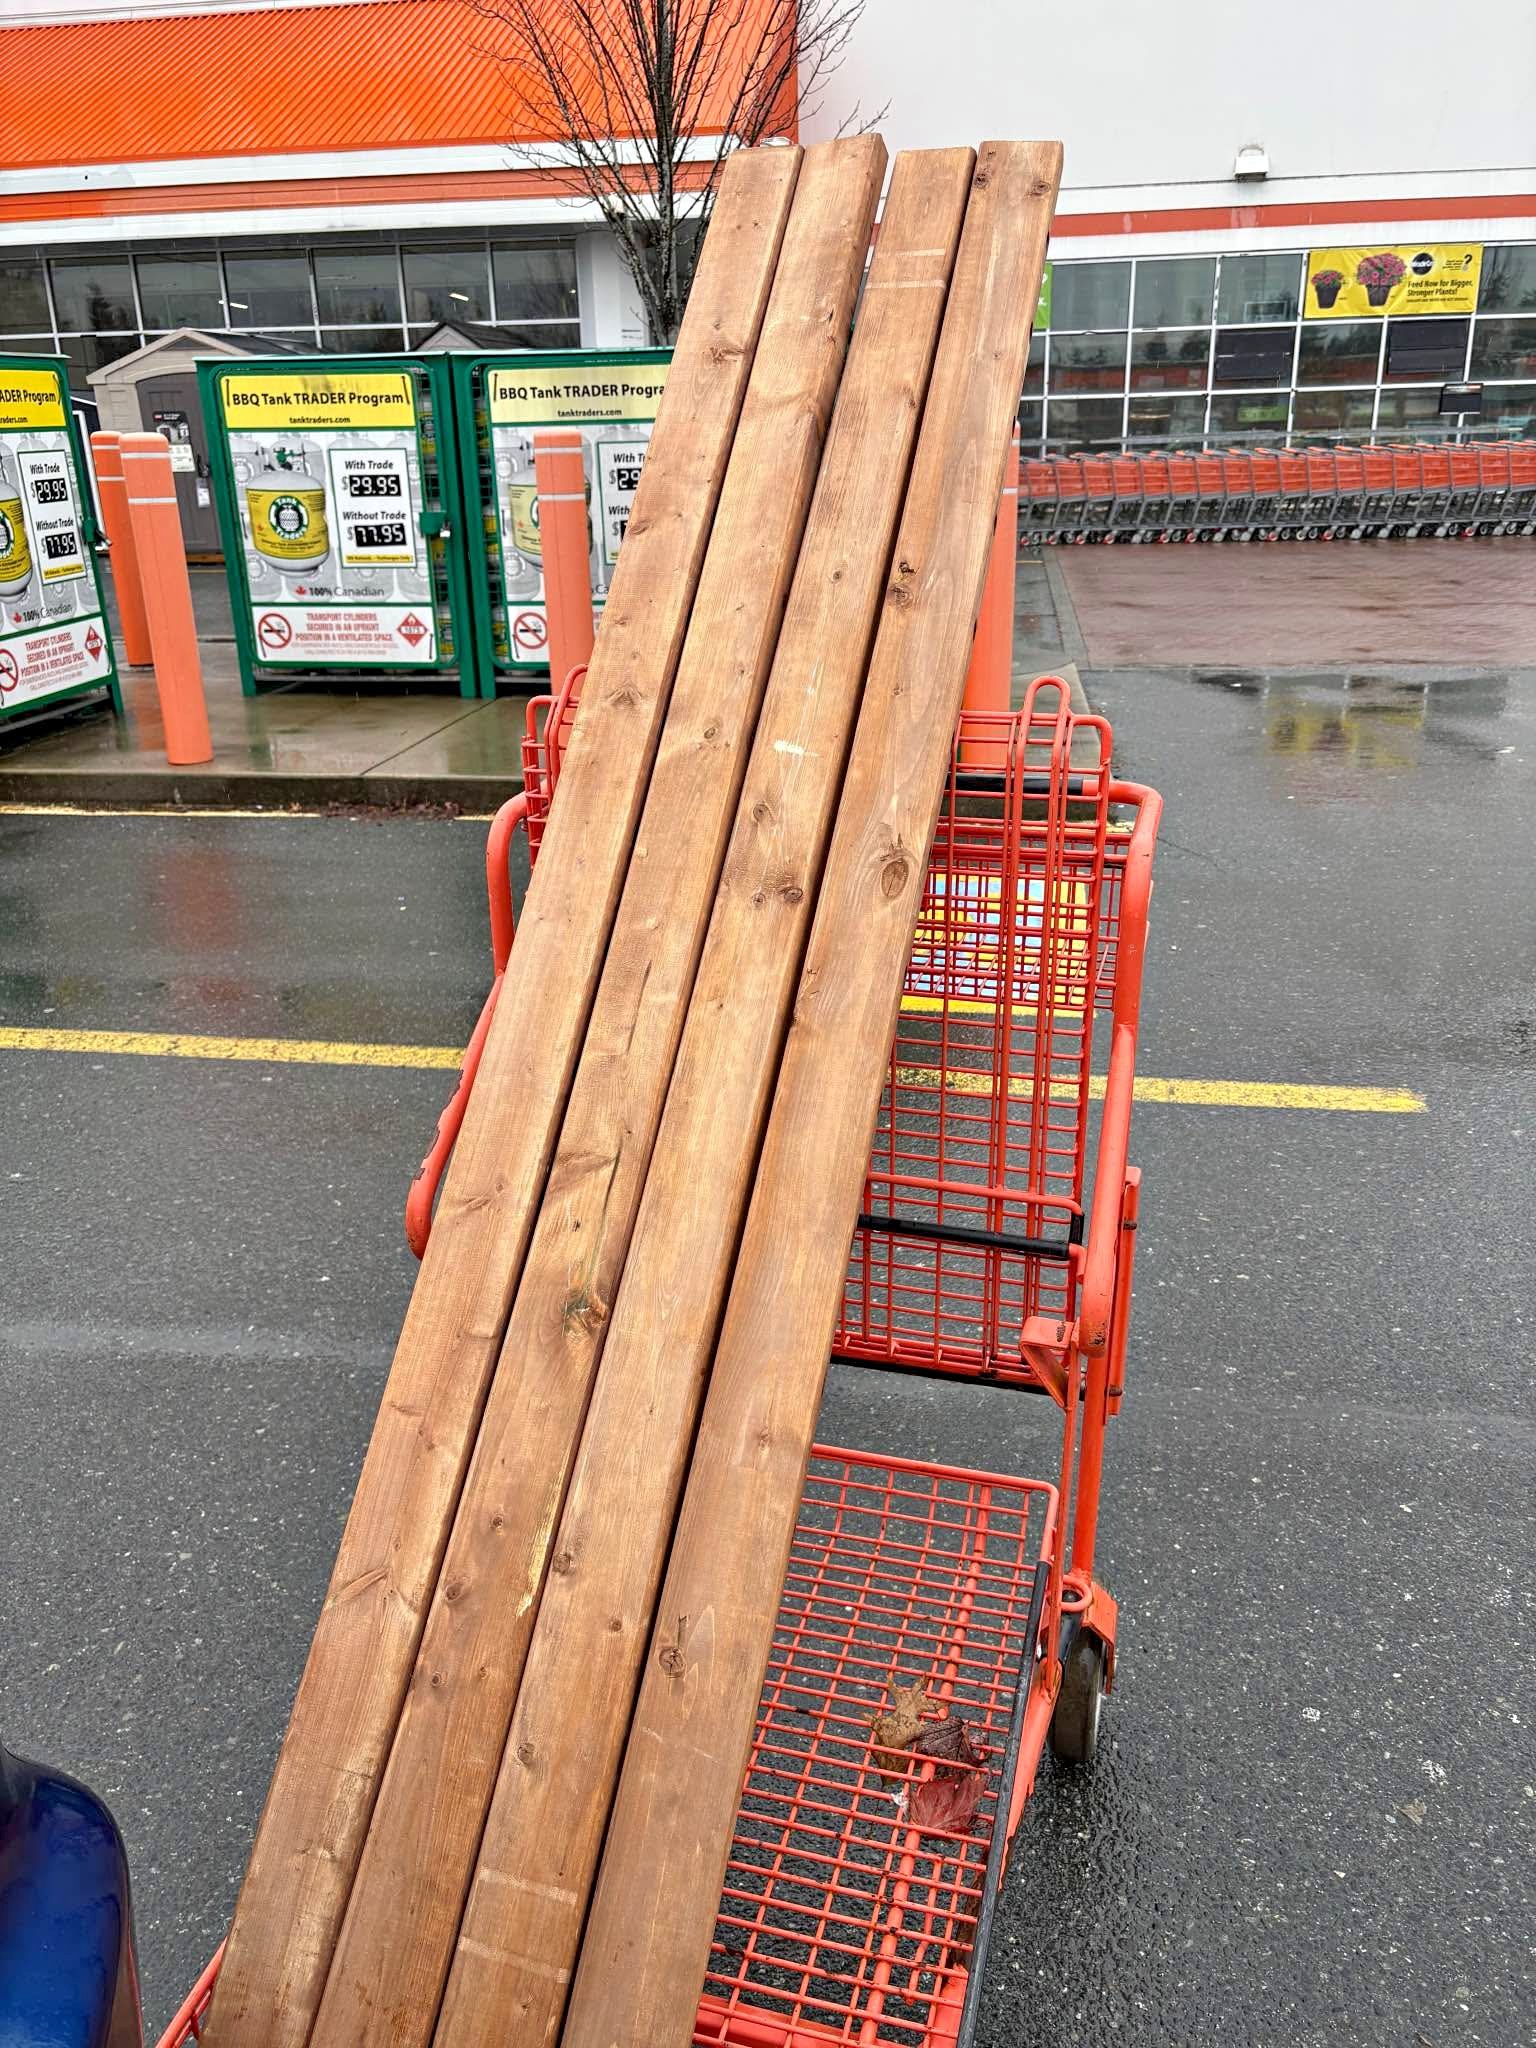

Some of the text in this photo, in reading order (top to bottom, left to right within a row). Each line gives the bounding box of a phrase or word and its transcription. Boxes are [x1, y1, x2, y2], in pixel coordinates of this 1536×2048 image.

[1408, 289, 1434, 297] Stronger
[500, 384, 664, 399] BBQ Tank TRADER Progra
[0, 389, 56, 405] ADER Program
[233, 392, 403, 407] BBQ Tank TRADER Program
[558, 408, 622, 417] tanktraders.com
[0, 416, 28, 424] raders.com
[289, 416, 350, 424] tanktraders.com
[614, 453, 635, 463] With
[30, 463, 60, 475] With Trade
[345, 460, 393, 470] With Trade
[609, 470, 641, 488] $29
[275, 497, 297, 507] Tank
[343, 511, 406, 520] Without Trade
[608, 506, 630, 515] With
[36, 518, 74, 531] Without Trade
[309, 586, 384, 596] 100% Canadian
[23, 604, 72, 622] 100% Canadian
[306, 613, 377, 621] TRANSPORT CYLINDERS
[296, 633, 323, 642] POSITION
[337, 633, 372, 641] VENTILATED
[374, 633, 393, 641] SPACE
